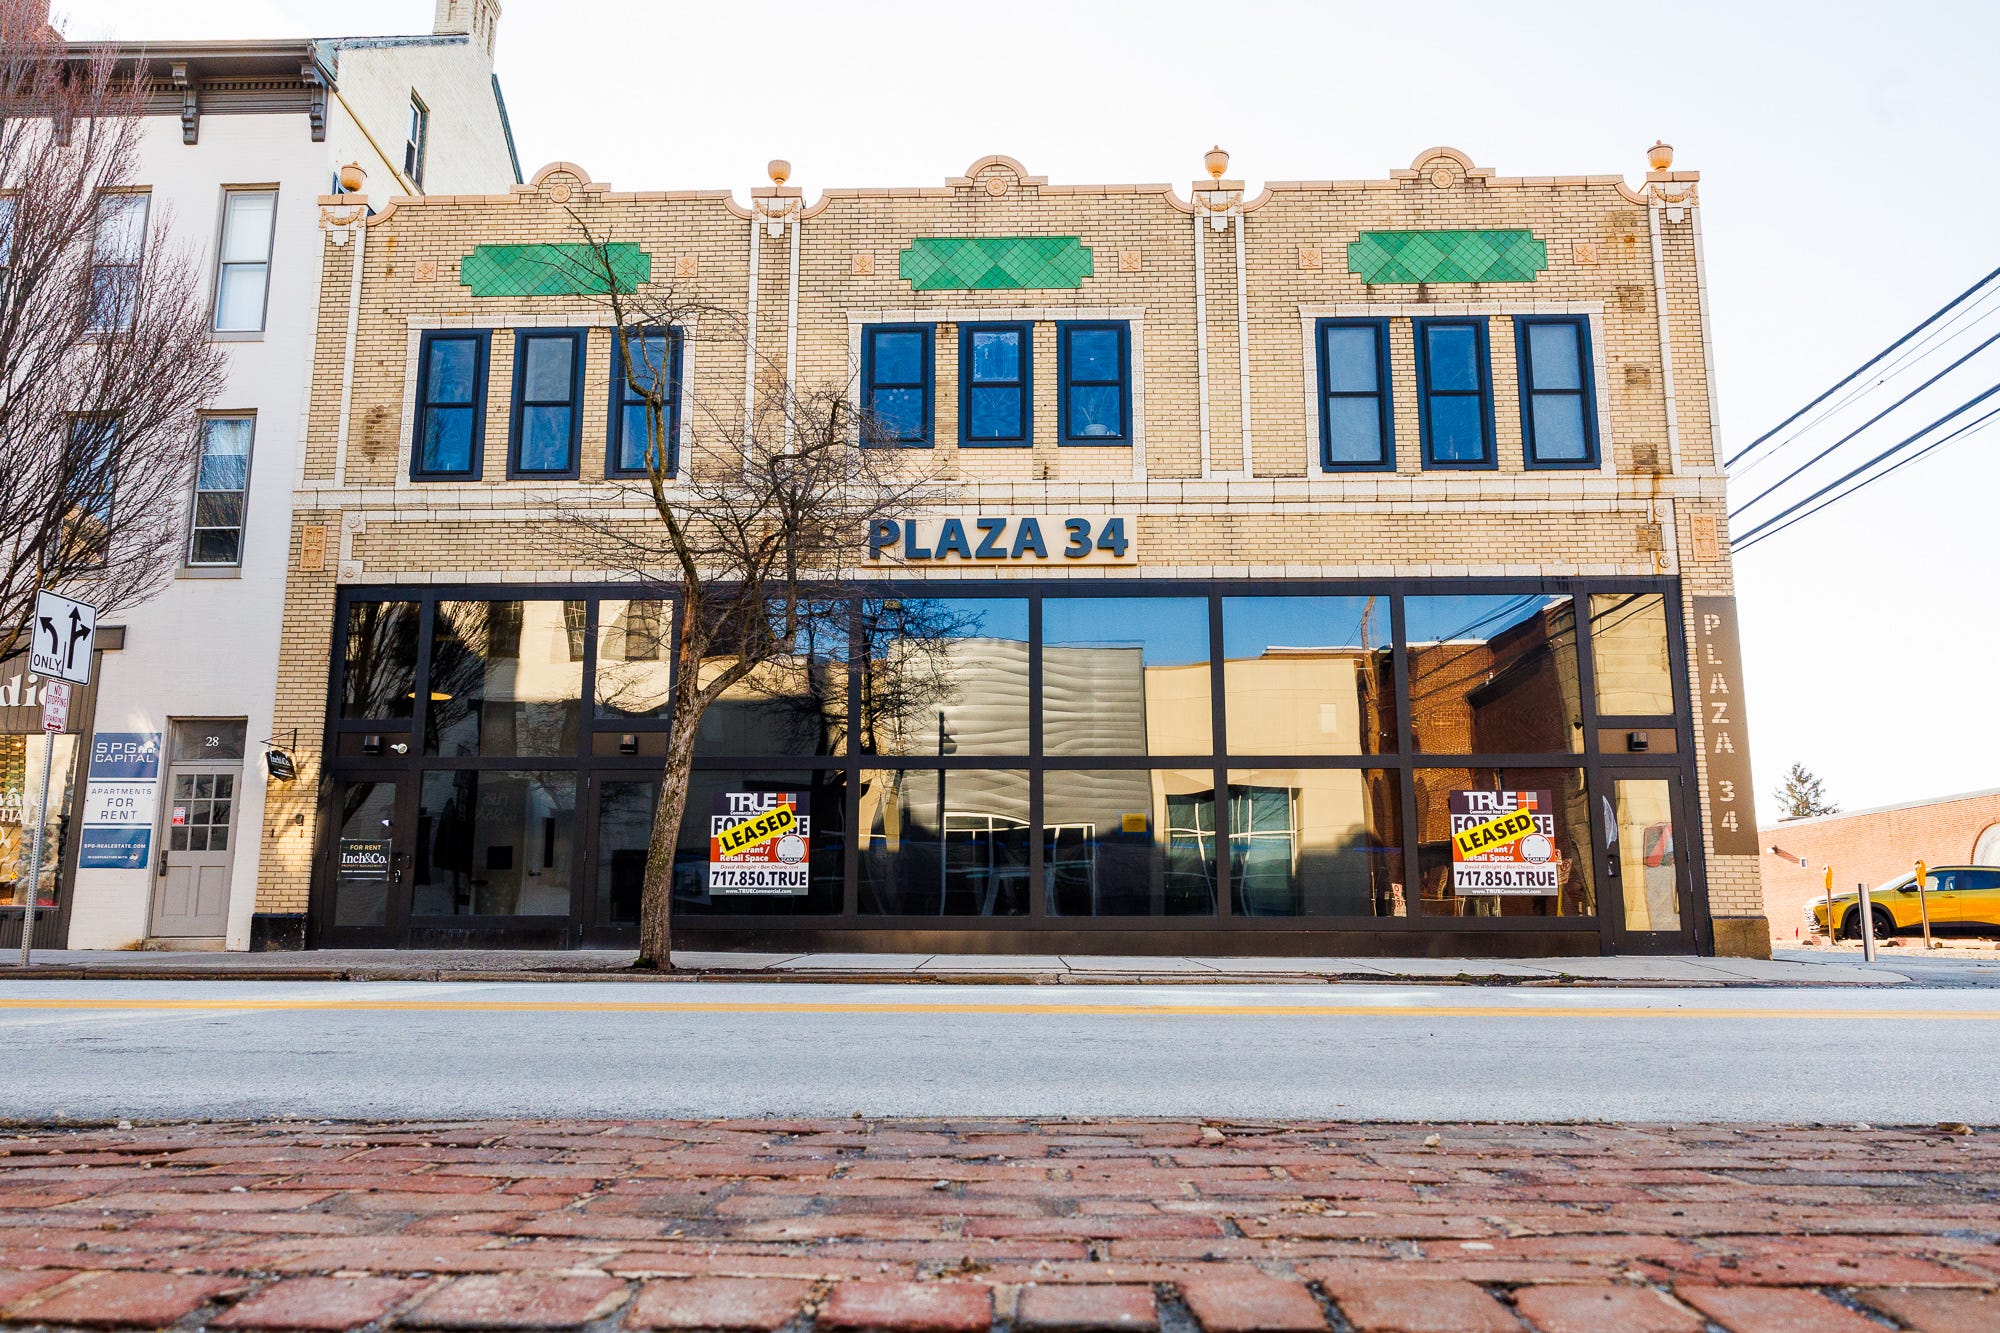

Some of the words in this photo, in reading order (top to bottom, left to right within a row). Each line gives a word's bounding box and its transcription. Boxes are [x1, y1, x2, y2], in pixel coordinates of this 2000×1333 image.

[869, 517, 1049, 559] PLAZA
[1064, 517, 1129, 558] 34
[33, 653, 62, 672] ONLY
[1703, 614, 1736, 754] PLAZA
[54, 685, 63, 697] NO
[47, 694, 68, 708] STOPPING
[53, 707, 59, 715] OR
[45, 714, 65, 725] STANDING
[96, 742, 137, 754] SPG
[205, 736, 219, 747] 28
[95, 754, 154, 763] CAPITAL
[107, 797, 134, 807] FOR
[726, 792, 777, 811] TRUE
[1463, 791, 1517, 810] TRUE
[1718, 780, 1739, 833] 34
[100, 810, 138, 820] RENT
[721, 811, 791, 852] LEASED
[1459, 814, 1530, 852] LEASED
[341, 852, 388, 864] Inch&Co.
[745, 854, 769, 863] Space
[1489, 854, 1514, 862] Space
[712, 871, 807, 886] 717.850.TRUE
[1456, 871, 1556, 886] 717.850.TRUE
